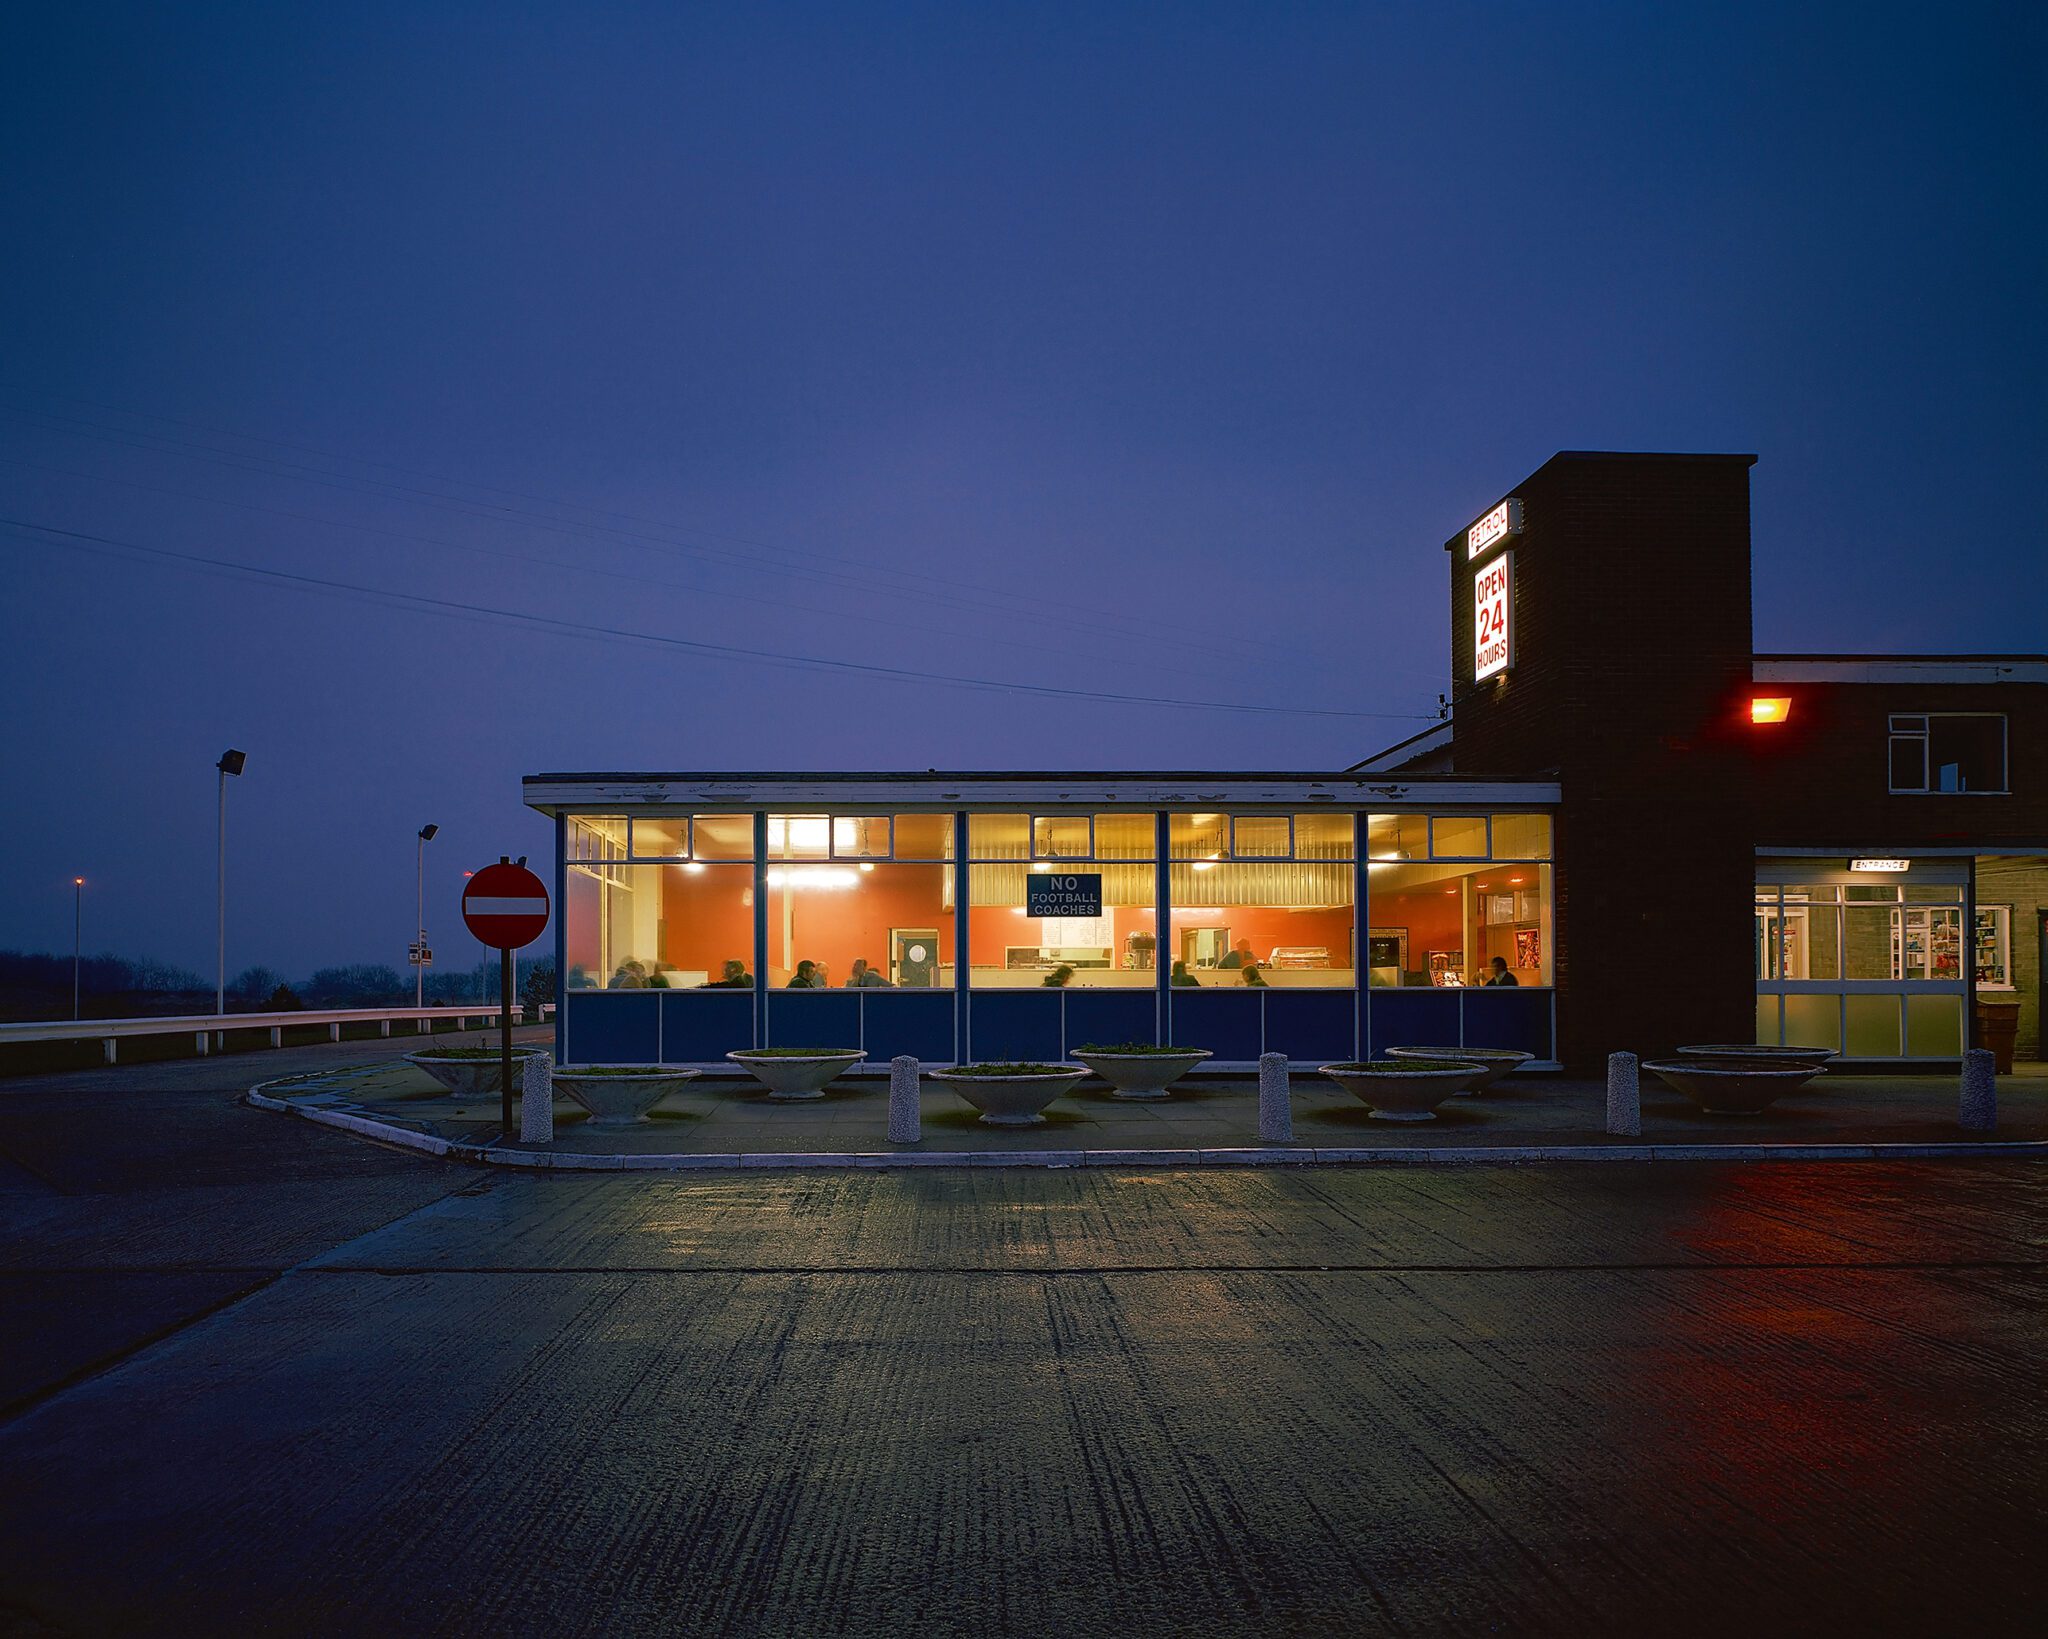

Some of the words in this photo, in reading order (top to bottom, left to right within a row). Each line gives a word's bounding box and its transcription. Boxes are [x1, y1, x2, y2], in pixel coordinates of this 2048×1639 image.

[1470, 508, 1506, 547] PETROL
[1477, 565, 1505, 604] OPEN
[1480, 599, 1504, 645] 24
[1477, 639, 1506, 670] HOURS
[1856, 861, 1905, 869] ENTRANCE
[1051, 876, 1077, 890] NO
[1031, 893, 1097, 903] FOOTBALL
[1034, 905, 1095, 915] COACHES
